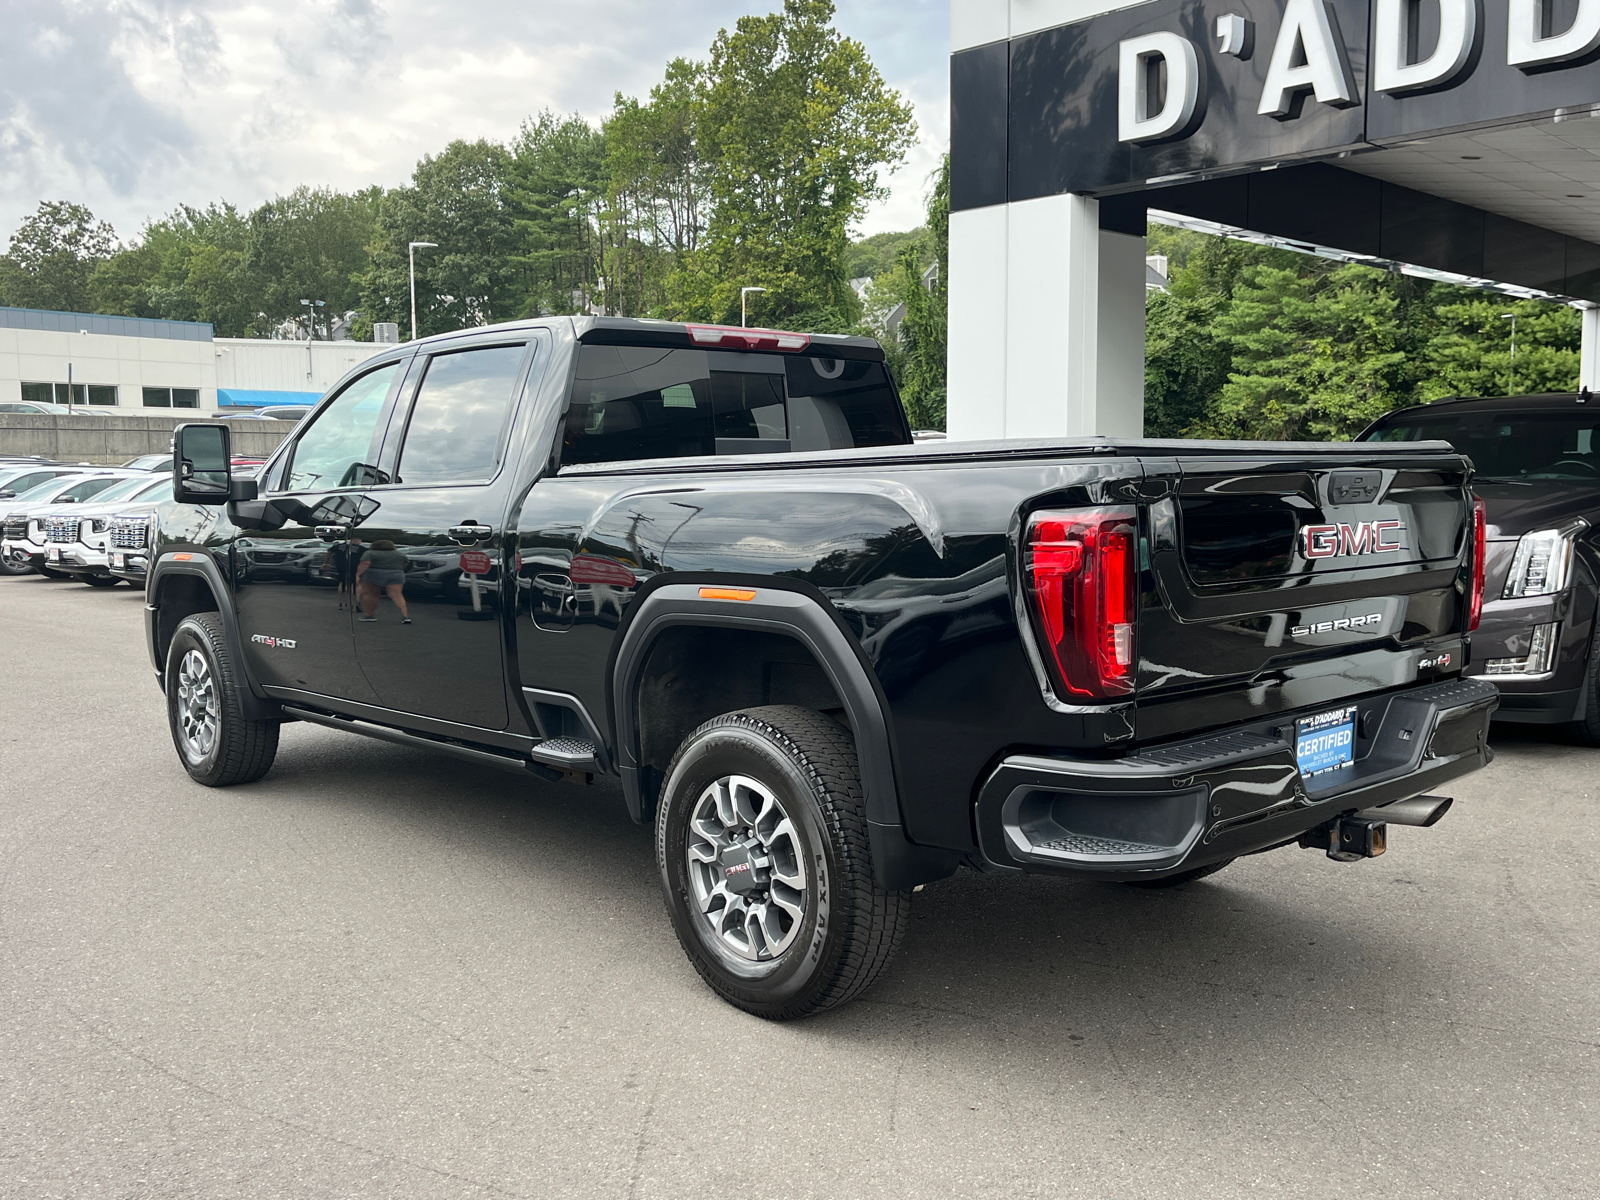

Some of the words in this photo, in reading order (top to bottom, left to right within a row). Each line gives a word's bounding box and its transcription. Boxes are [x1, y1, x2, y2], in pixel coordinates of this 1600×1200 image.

[1300, 520, 1400, 559] GMC
[1290, 613, 1382, 637] SIERRA
[251, 634, 275, 648] AT4
[276, 638, 297, 648] HD
[1297, 729, 1351, 757] CERTIFIED
[815, 854, 827, 904] LTX
